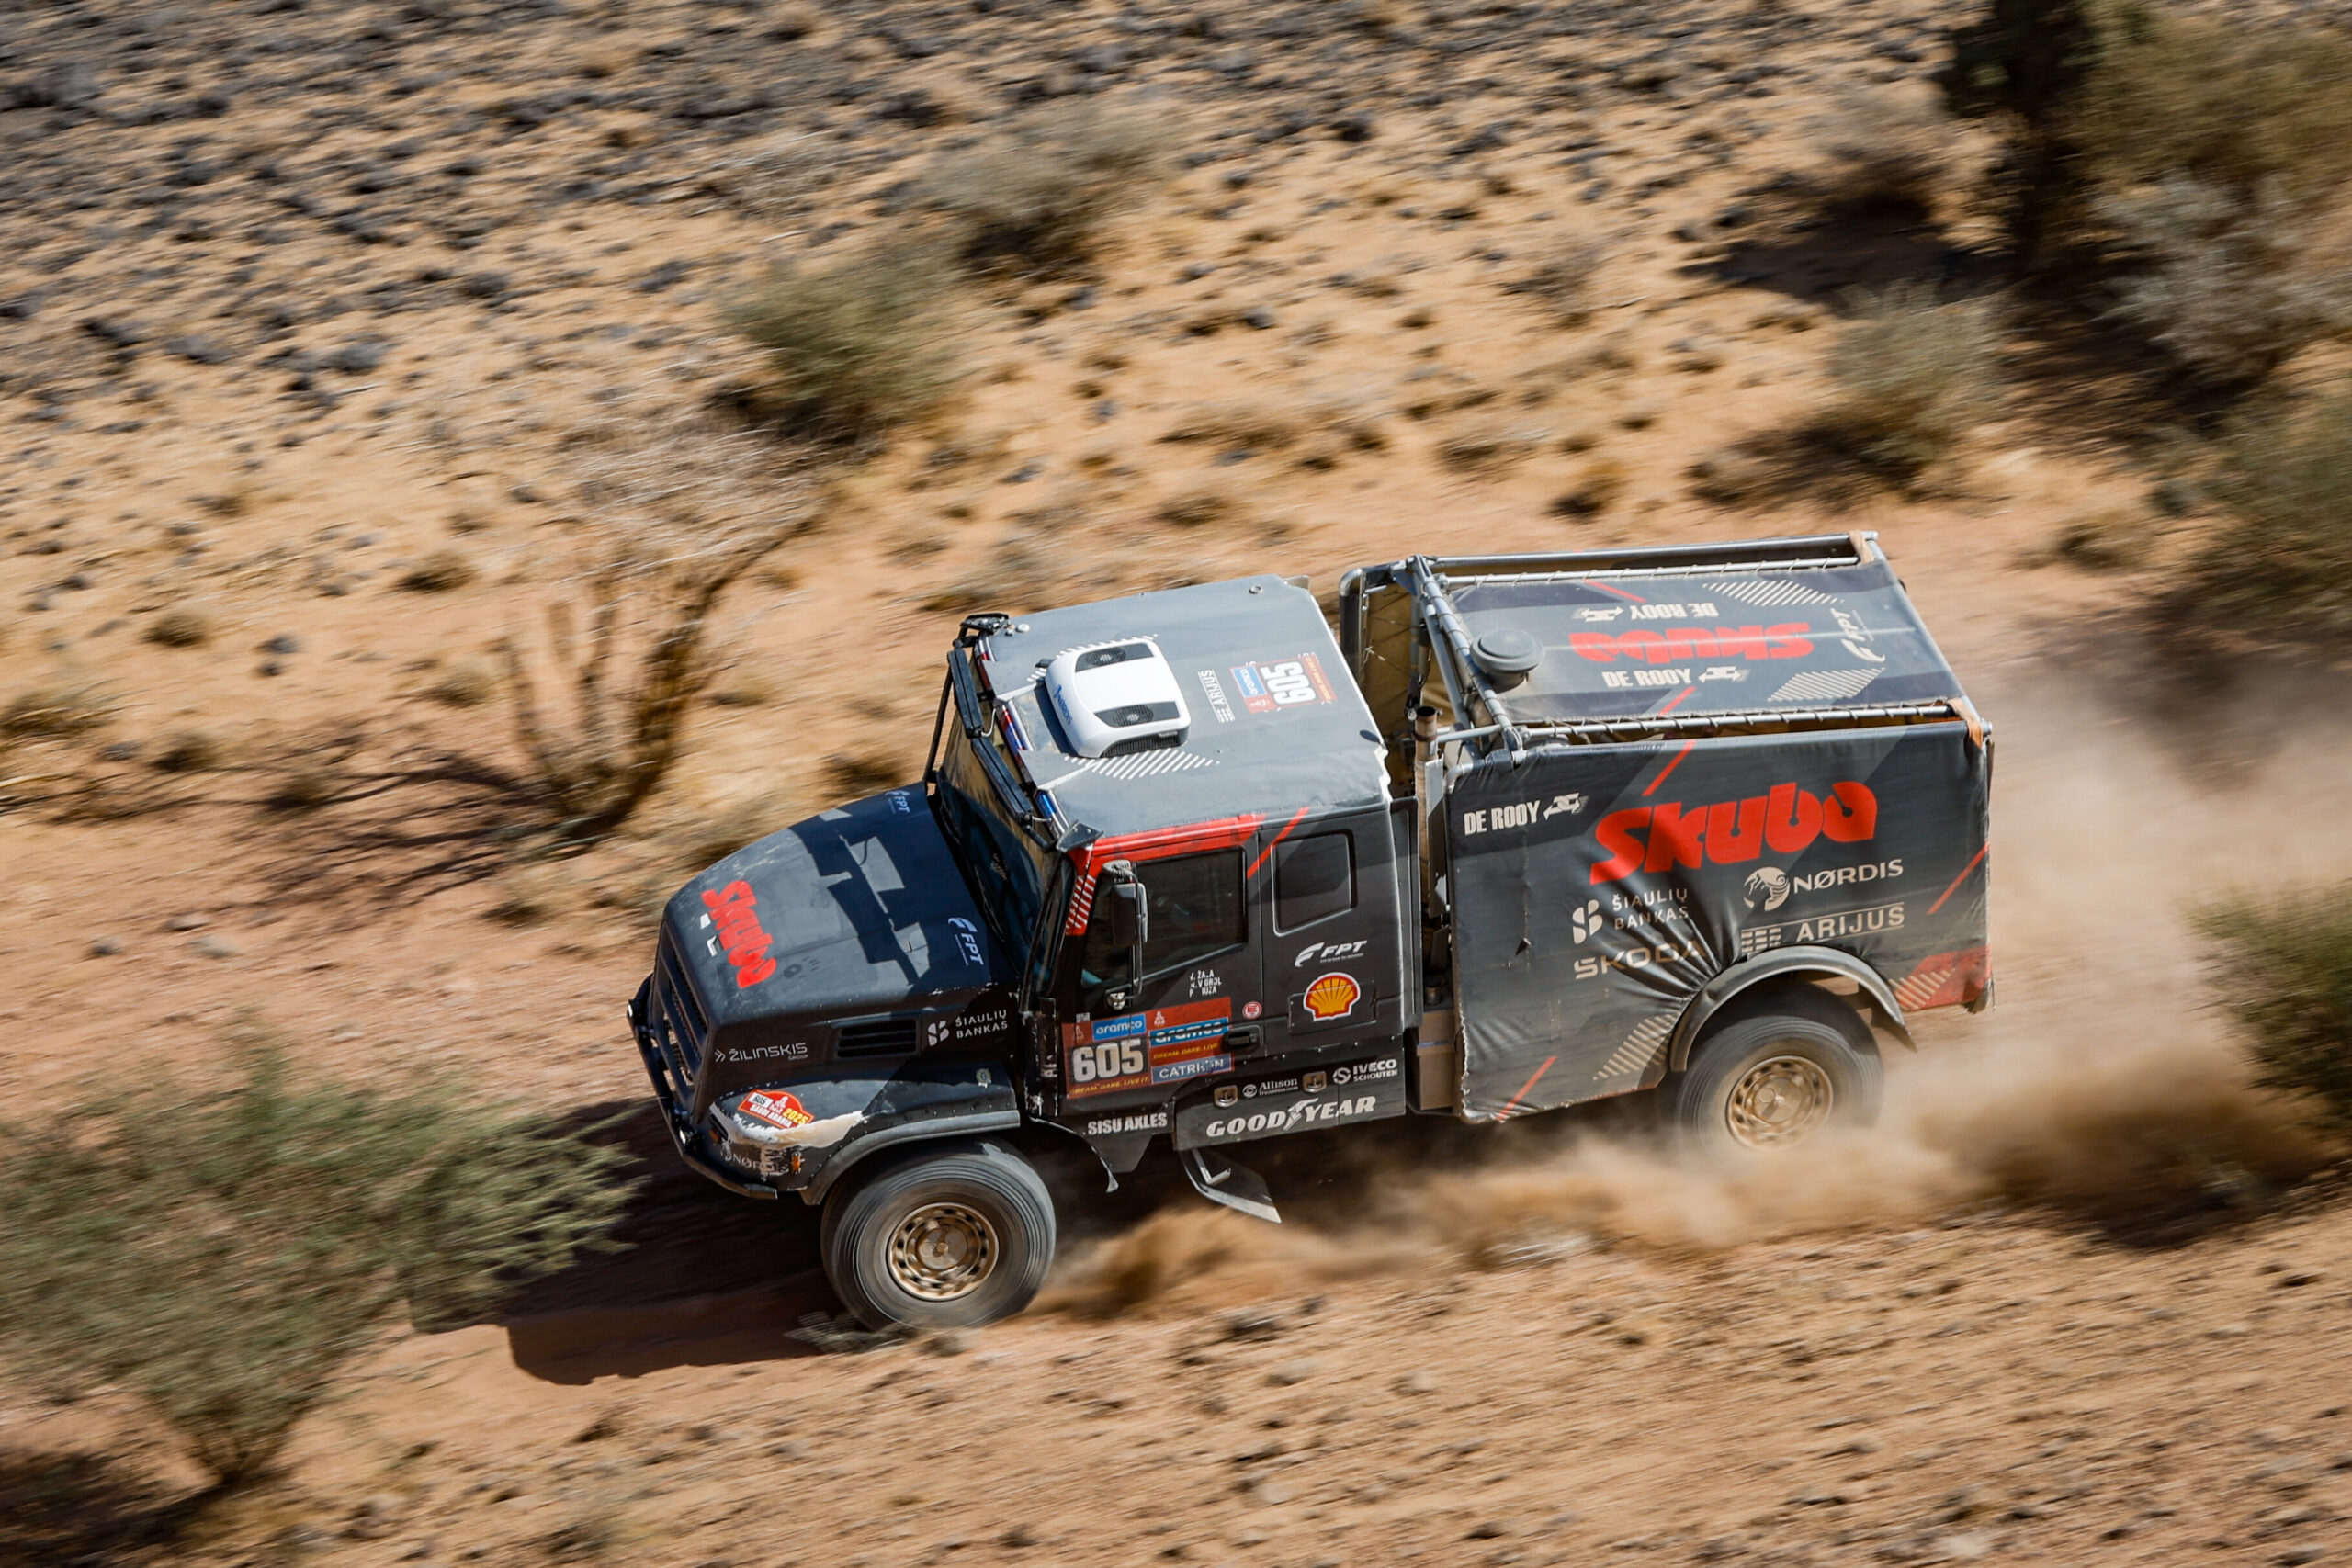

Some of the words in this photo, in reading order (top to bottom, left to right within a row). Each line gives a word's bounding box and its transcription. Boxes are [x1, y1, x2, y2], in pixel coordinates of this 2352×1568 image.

[1830, 607, 1866, 641] FPT
[1201, 669, 1226, 705] ARIJUS
[1240, 668, 1260, 695] aramco
[1260, 661, 1316, 705] 605
[1601, 671, 1634, 688] DE
[1634, 668, 1692, 686] ROOY
[895, 795, 910, 813] FPT
[1464, 810, 1487, 835] DE
[1491, 800, 1541, 830] ROOY
[1793, 859, 1904, 895] NØRDIS
[1612, 888, 1688, 912] ŠIAULIŲ
[1614, 906, 1689, 930] BANKAS
[1796, 906, 1905, 942] ARIJUS
[961, 932, 984, 965] FPT
[1320, 940, 1368, 958] FPT
[956, 1009, 1008, 1027] ŠIAULIŲ
[1096, 1020, 1142, 1034] aramco
[956, 1021, 1008, 1039] BANKAS
[729, 1043, 808, 1062] ŽILINSKIS
[1073, 1038, 1143, 1082] 605
[1353, 1059, 1397, 1075] IVECO
[1353, 1069, 1397, 1082] SCHOUTEN
[1260, 1077, 1298, 1091] Allison
[753, 1095, 768, 1105] 605
[782, 1108, 809, 1125] 2025
[1088, 1117, 1122, 1134] SISU
[1125, 1112, 1167, 1131] AXLES
[1206, 1096, 1376, 1137] GOODYEAR
